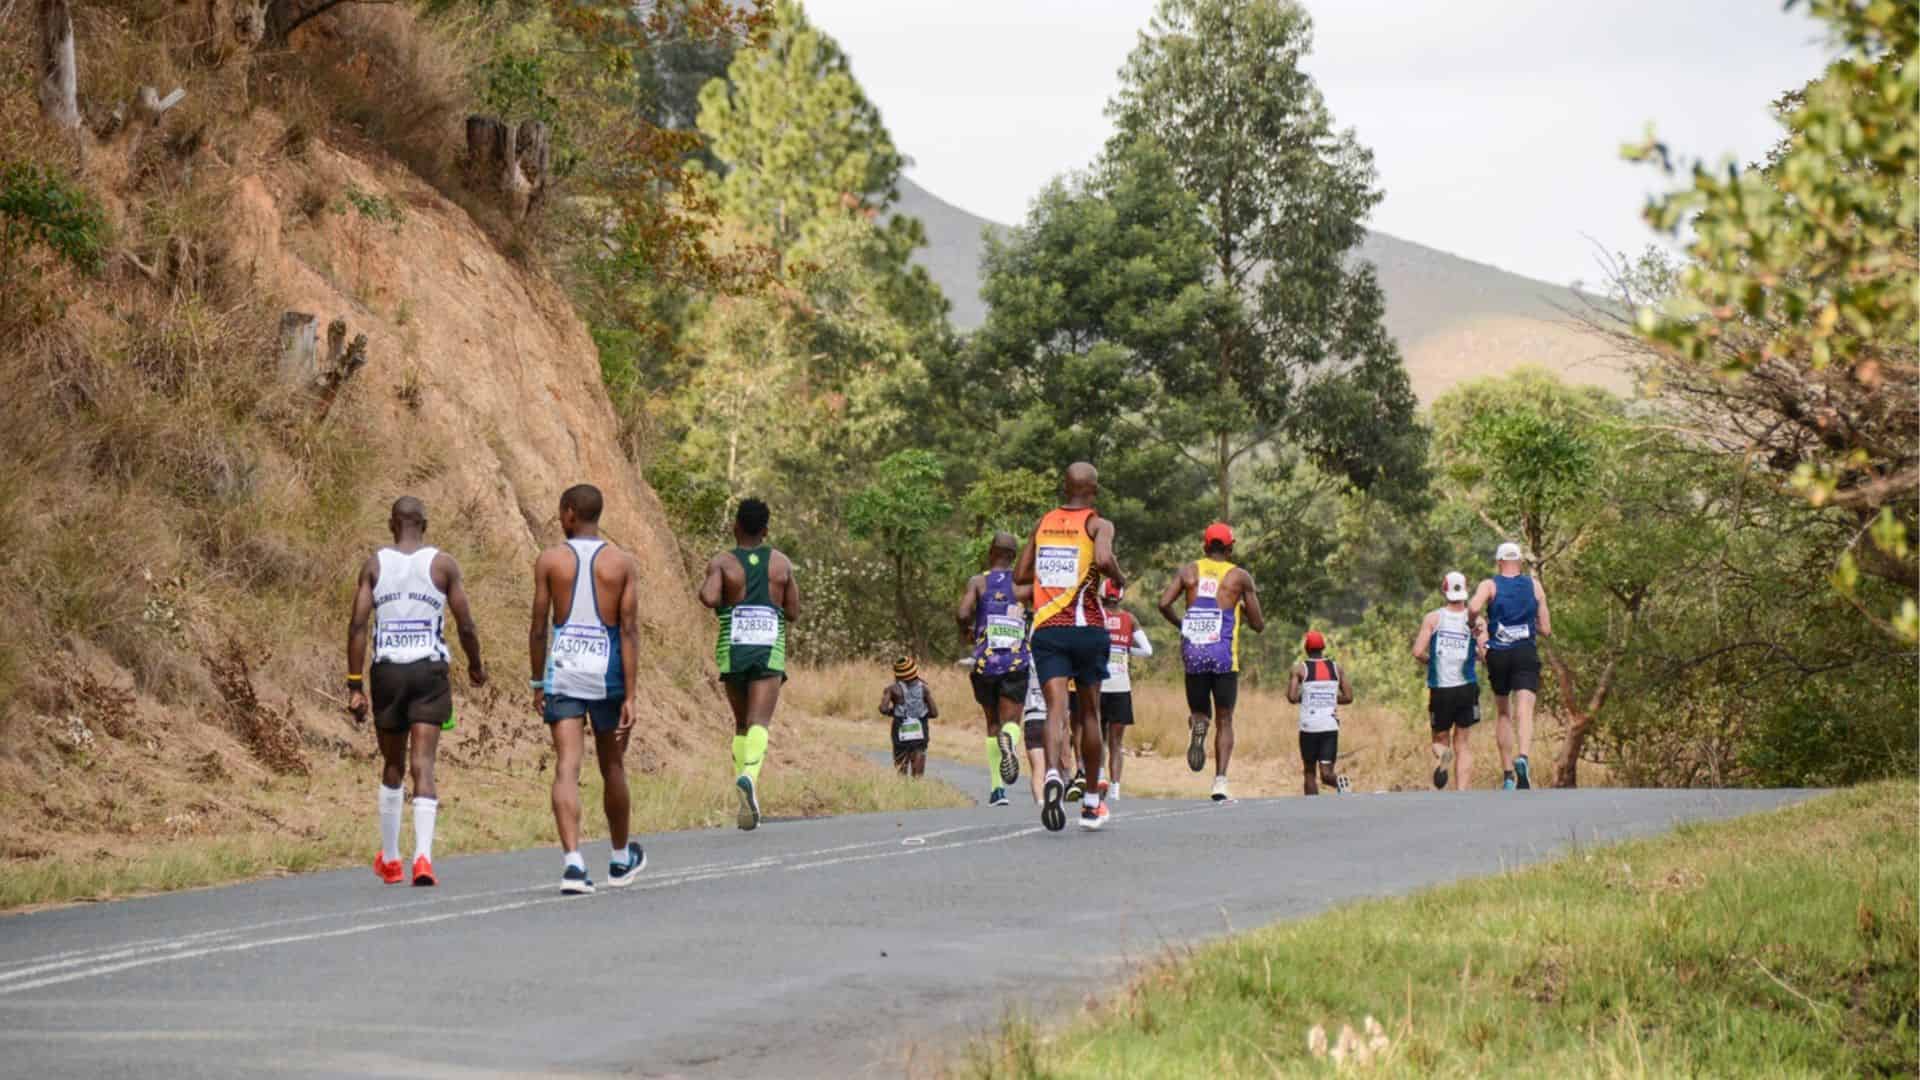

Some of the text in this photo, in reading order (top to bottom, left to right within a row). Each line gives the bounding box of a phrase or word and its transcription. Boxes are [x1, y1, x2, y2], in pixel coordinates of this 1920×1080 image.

[1201, 581, 1217, 593] 40
[385, 634, 427, 648] A30173
[557, 638, 605, 657] A30743
